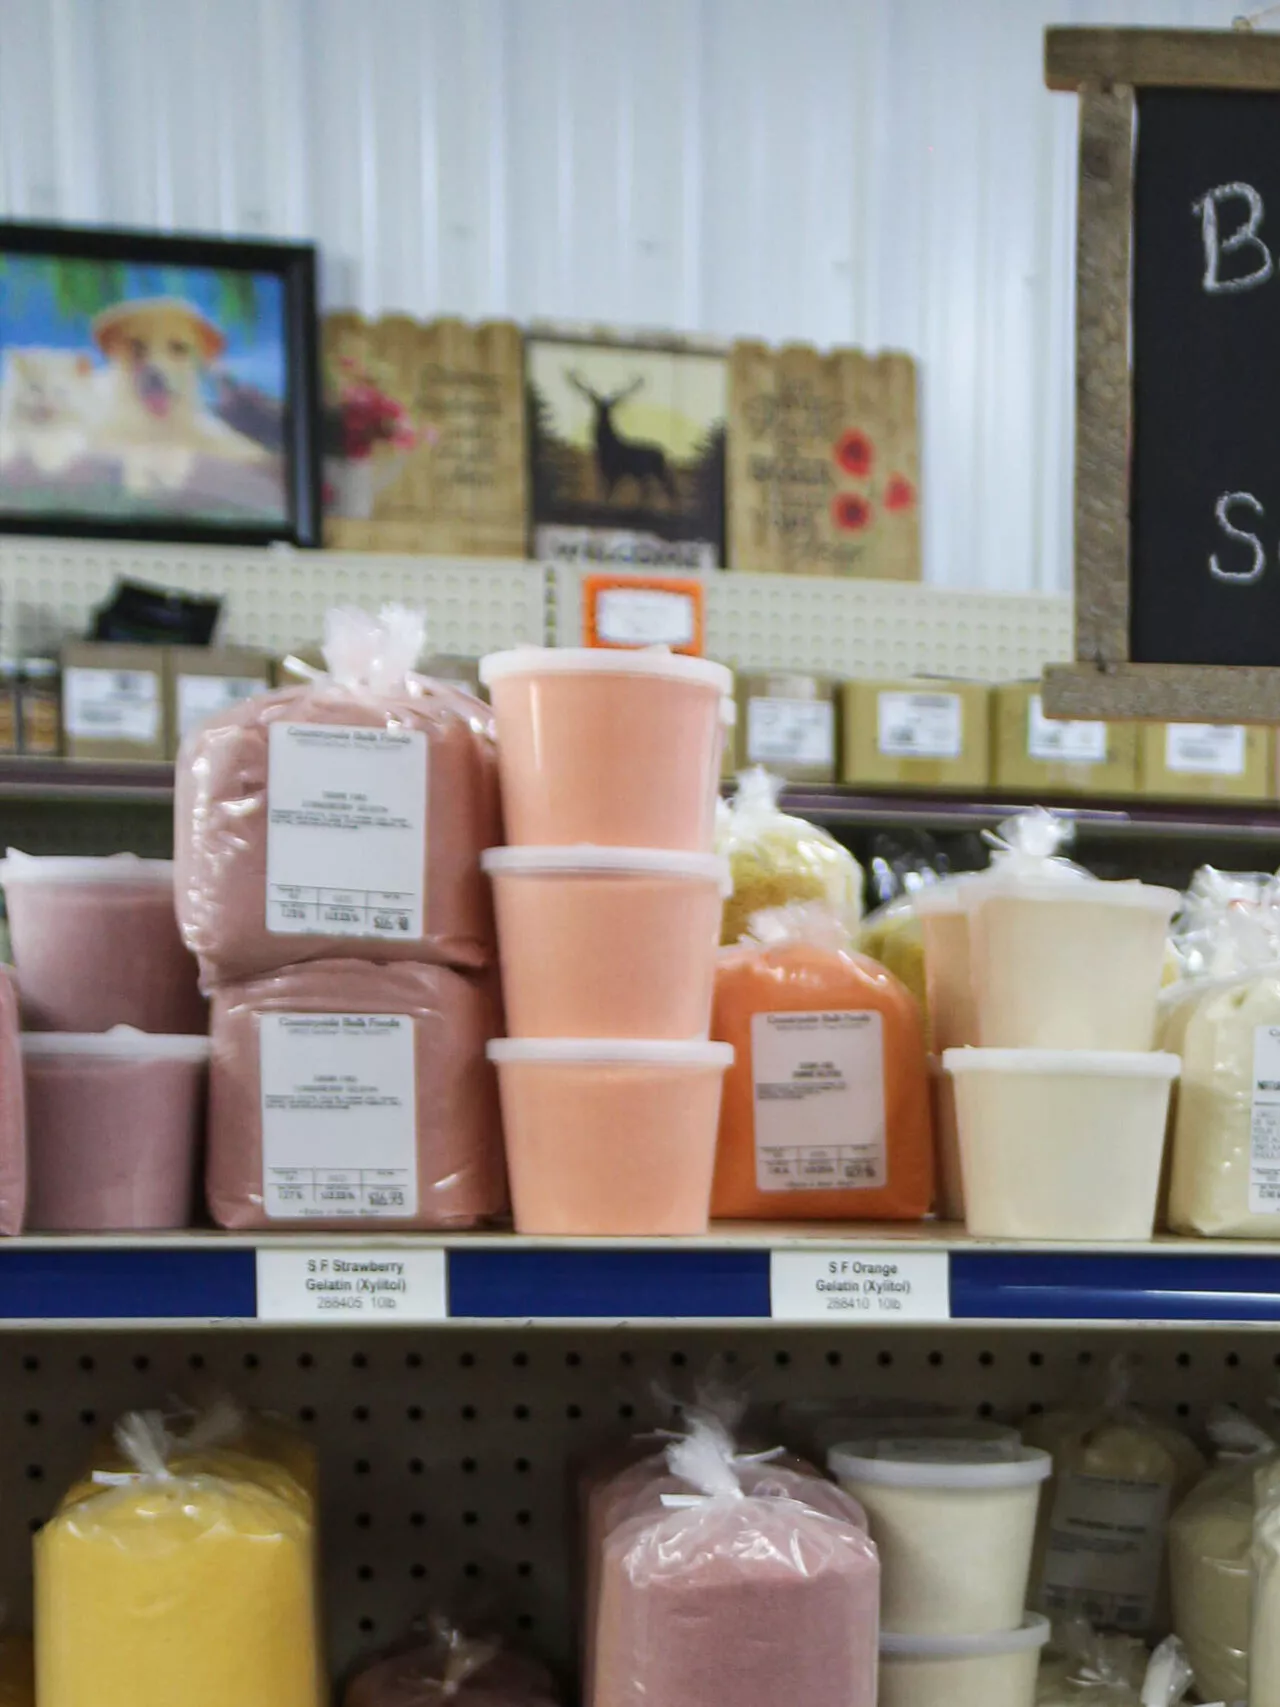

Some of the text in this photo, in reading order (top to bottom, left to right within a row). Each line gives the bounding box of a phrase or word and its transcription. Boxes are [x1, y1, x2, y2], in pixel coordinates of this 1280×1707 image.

[307, 1259, 404, 1275] S F Strawberry
[829, 1261, 898, 1277] S F Orange
[306, 1279, 406, 1293] Gelatin (Xylitol)
[816, 1279, 911, 1294] Gelatin (Xylitol)
